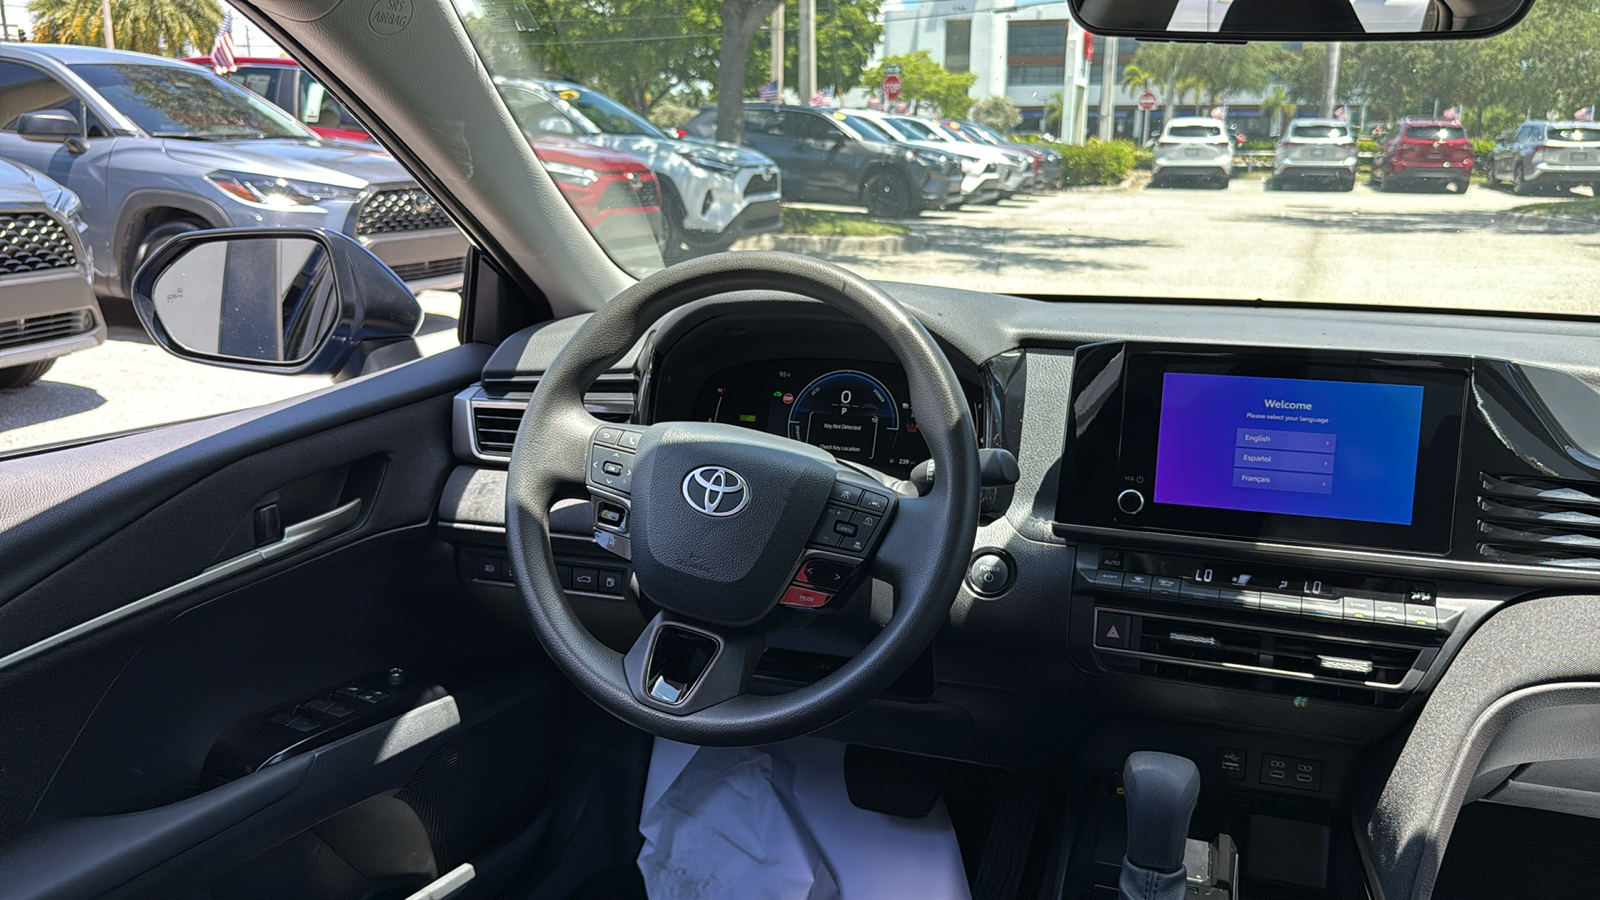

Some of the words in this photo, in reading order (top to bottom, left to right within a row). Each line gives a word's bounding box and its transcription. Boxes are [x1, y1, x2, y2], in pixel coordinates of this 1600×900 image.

[387, 0, 405, 12] SRS
[372, 11, 407, 27] AIRBAG
[811, 386, 821, 396] ECO
[872, 388, 886, 404] POWER
[840, 390, 852, 404] 0
[1264, 399, 1313, 411] Welcome
[841, 407, 848, 415] P
[1299, 416, 1329, 424] language
[1244, 434, 1271, 443] English
[1243, 454, 1272, 463] Español
[1241, 475, 1271, 483] Français
[1195, 569, 1213, 583] LO
[1304, 581, 1322, 595] LO
[799, 594, 815, 603] MODE
